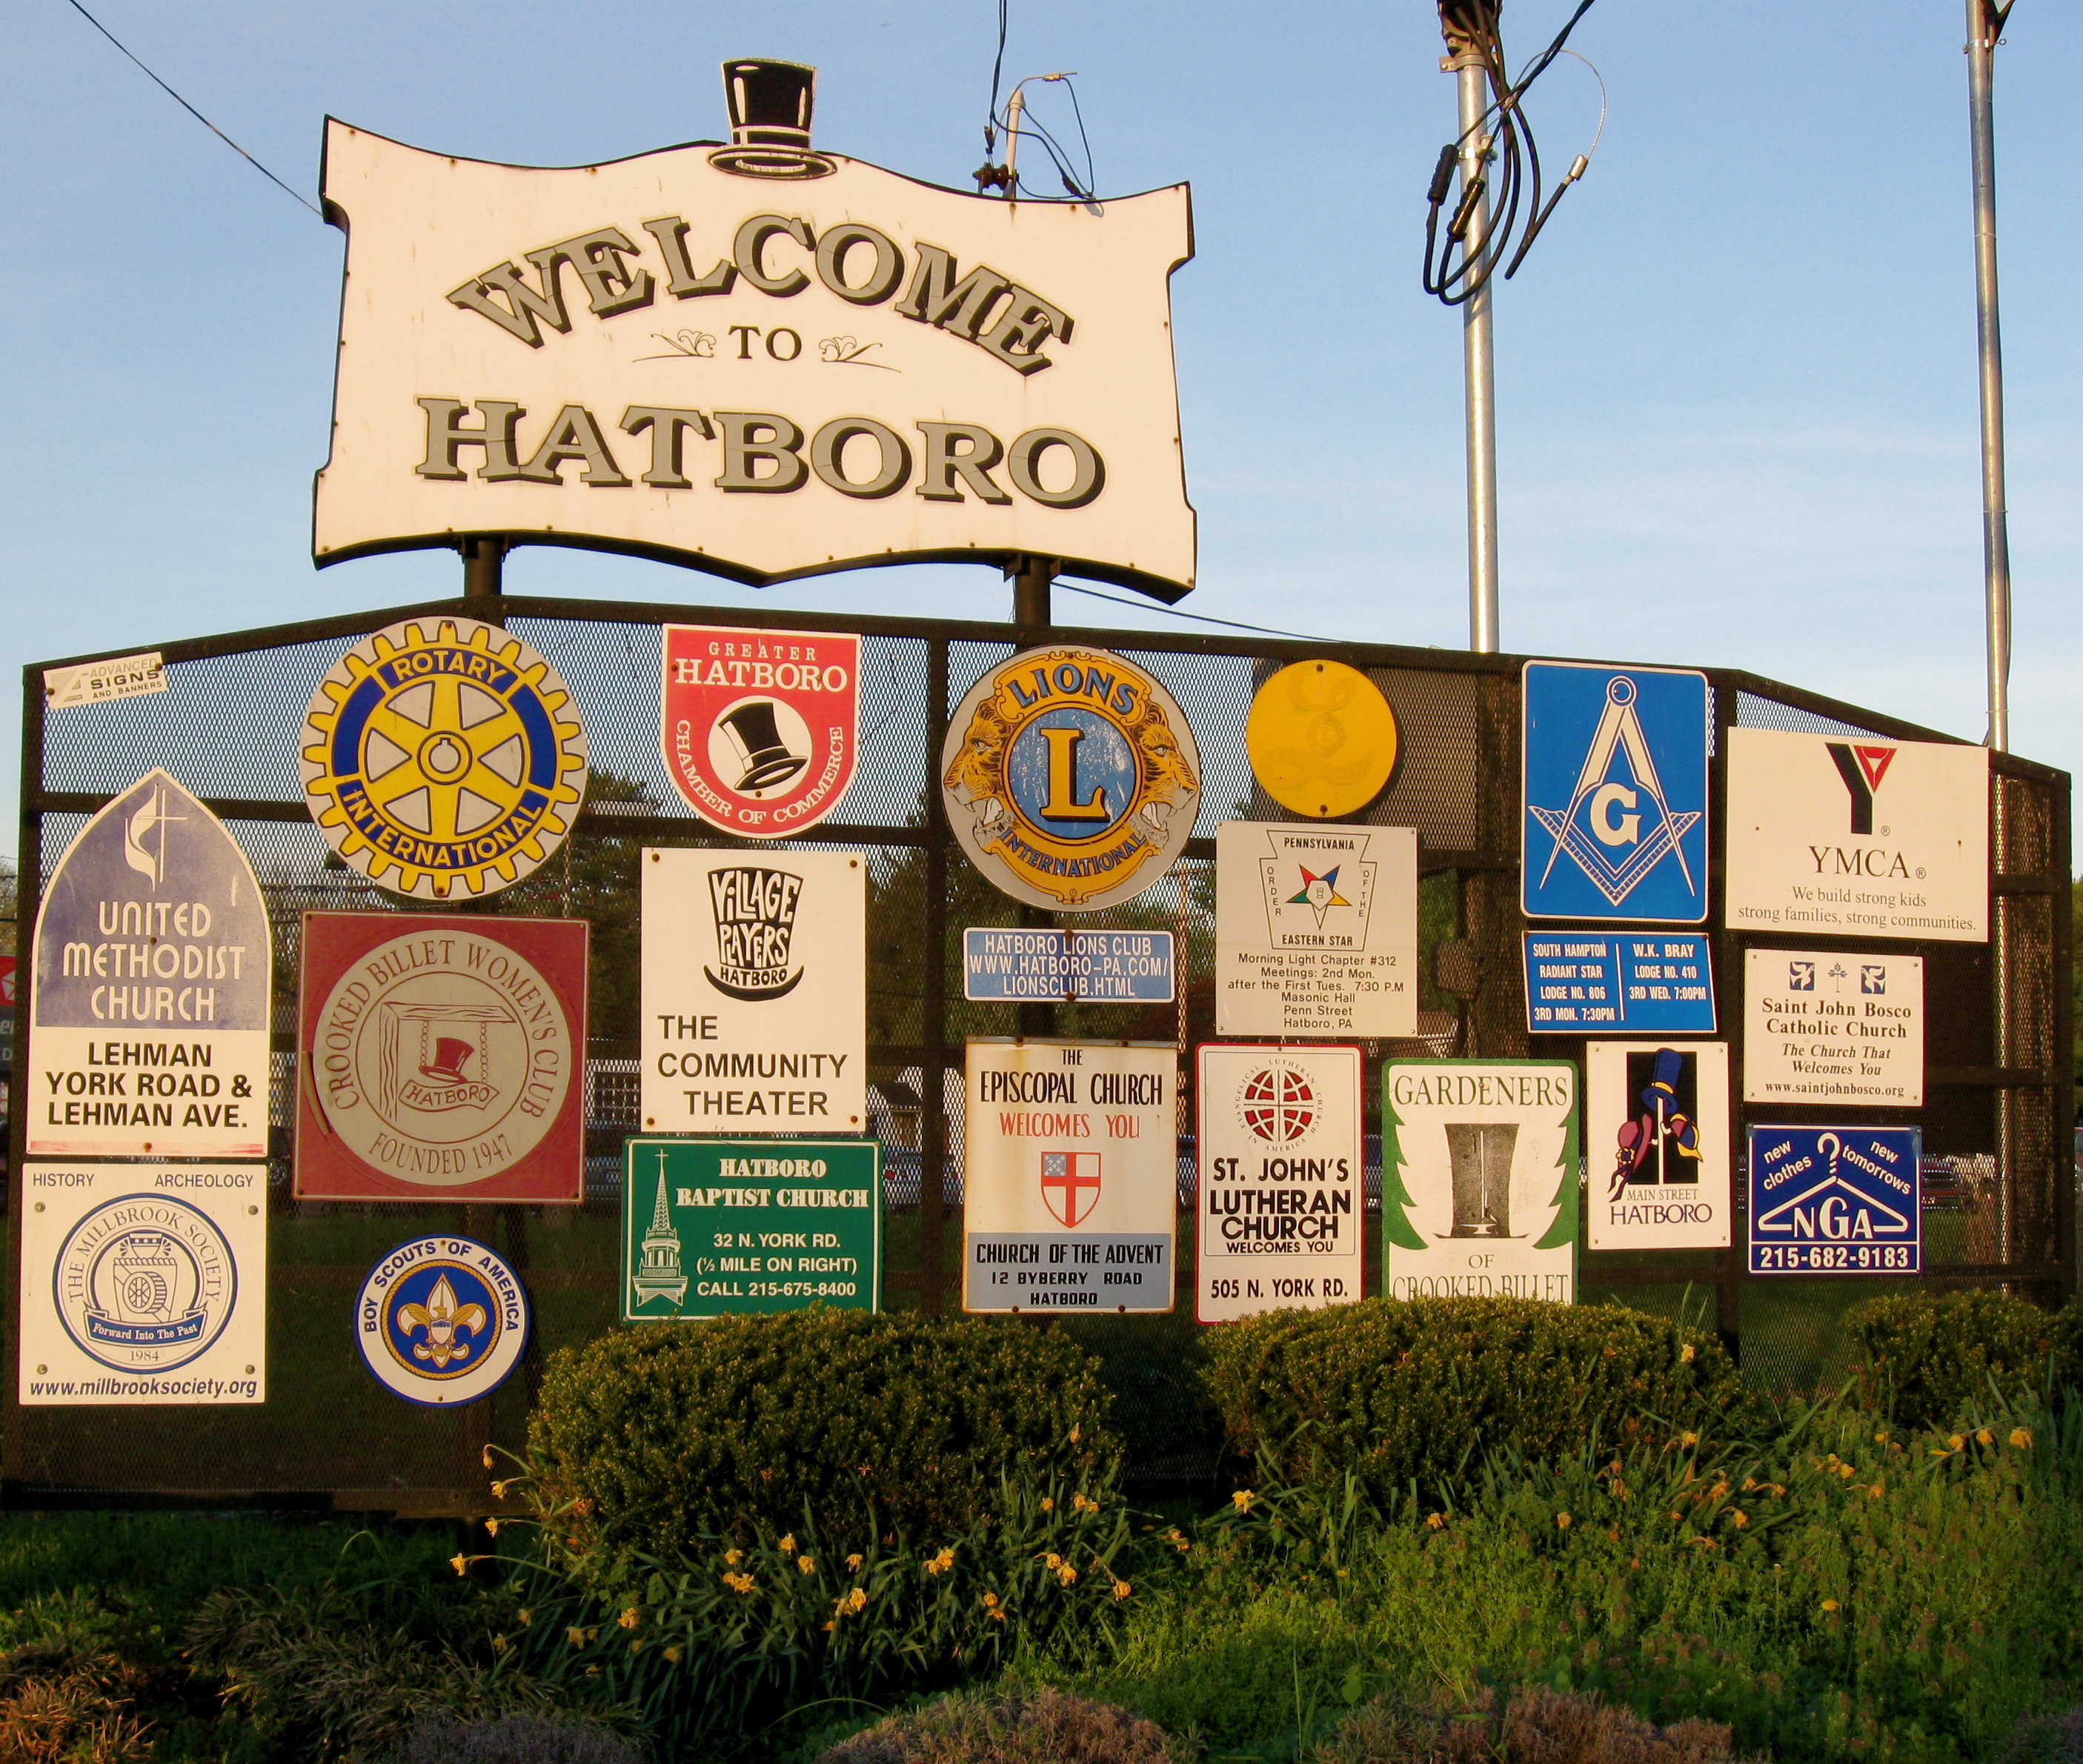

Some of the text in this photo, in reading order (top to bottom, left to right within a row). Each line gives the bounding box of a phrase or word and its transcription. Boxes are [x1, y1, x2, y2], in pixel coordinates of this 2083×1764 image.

[444, 210, 1077, 378] WELCOME
[728, 325, 804, 363] TO
[413, 393, 1109, 511] HATBORO
[708, 642, 815, 661] GREATER
[392, 650, 509, 684] ROTARY
[674, 658, 847, 692] HATBORO
[90, 670, 159, 690] SIGNS
[93, 681, 162, 699] AND BANNERS
[1006, 663, 1138, 714] LIONS
[1039, 728, 1112, 822] L
[738, 808, 766, 824] OF
[1589, 782, 1641, 847] G
[343, 789, 542, 866] INTERNATIONAL
[1000, 830, 1148, 878] INTERNATIONAL
[1284, 837, 1355, 851] PENNSYLVANIA
[1792, 887, 1927, 908] We build strong kids
[99, 901, 211, 937] UNITED
[1738, 907, 1976, 931] strong families, strong communities.
[985, 935, 1152, 956] HATBORO LIONS CLUB
[1282, 935, 1352, 946] EASTERN STAR
[1532, 944, 1607, 957] SOUTH HAMPTON
[1632, 944, 1694, 957] W.K. BRAY
[63, 942, 245, 980] METHODIST
[969, 955, 1168, 976] WWW.HATBORO-PA.COM/
[1238, 953, 1396, 966] Morning Light Chapter #312
[720, 966, 787, 986] HATBORO
[1261, 967, 1375, 979] Meetings: 2nd Mon.
[1540, 965, 1603, 978] RADIANT STAR
[1635, 965, 1697, 979] LODGE NO. 410
[1003, 976, 1135, 996] LIONSCLUB.HTML
[1228, 979, 1379, 991] after the First Tues. 7:30
[1540, 986, 1606, 999] LODGE NO. 806
[1629, 987, 1706, 1000] 3RD WED. 7:00PM
[91, 985, 215, 1021] CHURCH
[1281, 992, 1355, 1003] Masonic Hall
[1284, 1005, 1352, 1016] Penn Street
[1535, 1008, 1615, 1021] 3RD MON. 7:30PM
[1762, 998, 1911, 1018] Saint John Bosco
[657, 1015, 718, 1040] THE
[1284, 1019, 1352, 1030] Hatboro, PA
[1767, 1019, 1907, 1037] Catholic Church
[88, 1042, 211, 1067] LEHMAN
[1062, 1049, 1083, 1065] THE
[1782, 1043, 1891, 1059] The Church That
[657, 1053, 848, 1078] COMMUNITY
[1792, 1061, 1881, 1075] Welcomes You
[45, 1071, 220, 1097] YORK ROAD
[980, 1071, 1163, 1105] EPISCOPAL CHURCH
[1395, 1075, 1567, 1106] GARDENERS
[1765, 1082, 1904, 1097] www.saintjohnbosco.org
[406, 1085, 491, 1105] HATBORO
[683, 1091, 828, 1116] THEATER
[48, 1102, 247, 1128] LEHMAN AVE.
[1000, 1112, 1140, 1139] WELCOMES YOU
[368, 1131, 513, 1174] FOUNDED 1947
[1764, 1140, 1792, 1164] new
[1870, 1141, 1898, 1164] new
[719, 1158, 827, 1177] HATBORO
[1213, 1157, 1245, 1181] ST.
[1763, 1156, 1812, 1191] clothes
[1842, 1145, 1911, 1195] tomorrows
[33, 1174, 94, 1187] HISTORY
[155, 1174, 253, 1188] ARCHEOLOGY
[676, 1188, 869, 1208] BAPTIST CHURCH
[1210, 1189, 1350, 1215] LUTHERAN
[1627, 1189, 1698, 1201] MAIN STREET
[1610, 1203, 1712, 1225] HATBORO
[1794, 1196, 1873, 1239] NGA
[1221, 1216, 1338, 1240] CHURCH
[714, 1234, 840, 1248] 32 N. YORK RD.
[1226, 1242, 1333, 1254] WELCOMES YOU
[977, 1243, 1163, 1264] CHURCH OF THE ADVENT
[1468, 1254, 1494, 1268] OF
[1760, 1247, 1908, 1268] 215-682-9183
[720, 1258, 857, 1276] MILE ON RIGHT)
[364, 1242, 519, 1333] BOY SCOUTS OF AMERICA
[991, 1272, 1142, 1285] 12 BYBERRY ROAD
[1211, 1279, 1347, 1298] 505 N. YORK RD.
[697, 1282, 856, 1297] CALL 215-675-8400
[1031, 1293, 1097, 1305] HATBORO
[92, 1322, 198, 1340] Forward Into The Past
[130, 1351, 159, 1362] 1984
[30, 1378, 257, 1398] www.millbrooksociety.org
